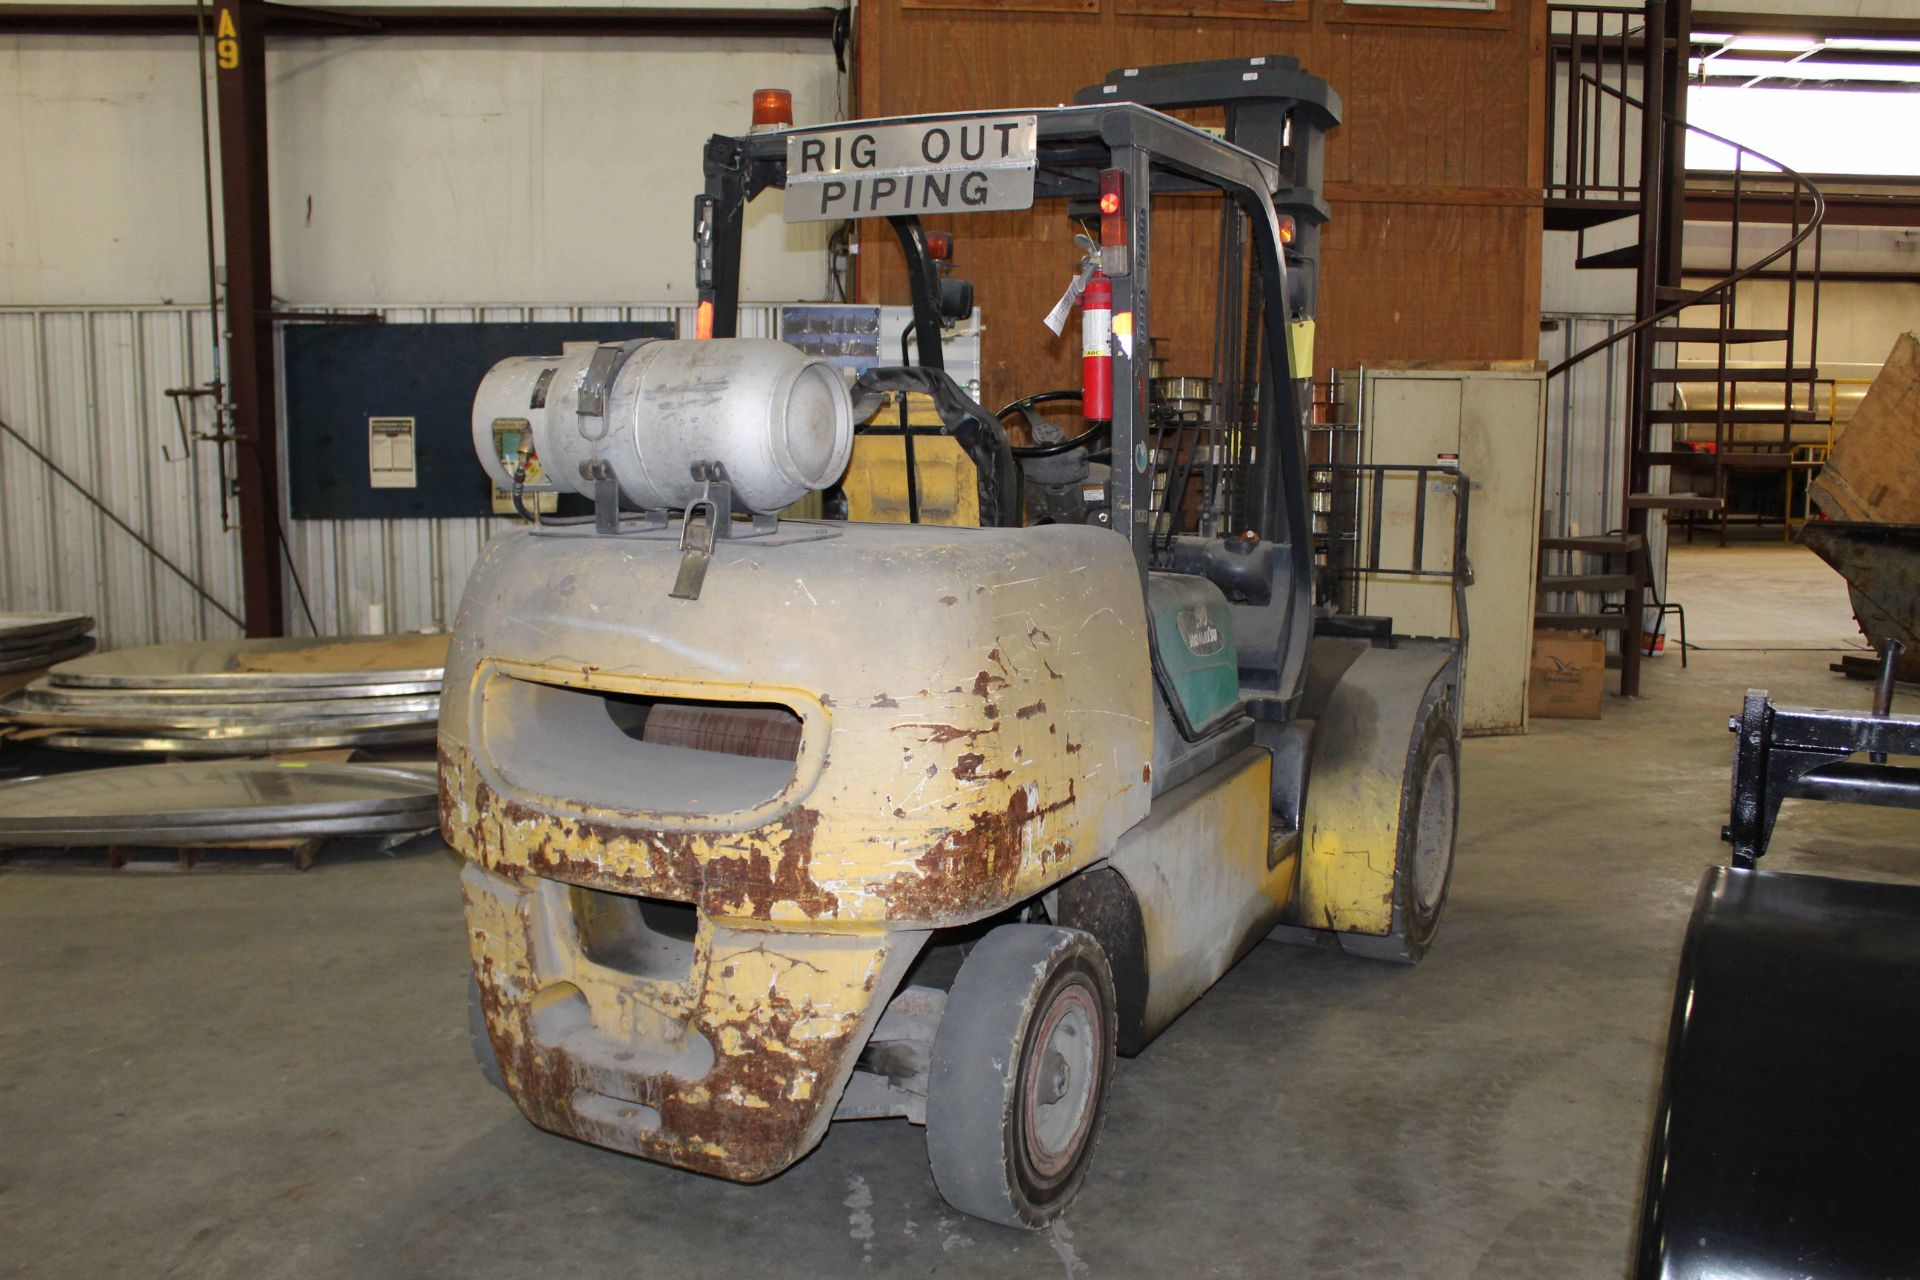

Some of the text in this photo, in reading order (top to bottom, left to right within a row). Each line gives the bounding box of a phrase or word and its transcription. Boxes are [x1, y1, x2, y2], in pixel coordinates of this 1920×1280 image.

[801, 123, 1018, 173] RIG OUT
[821, 172, 988, 213] PIPING
